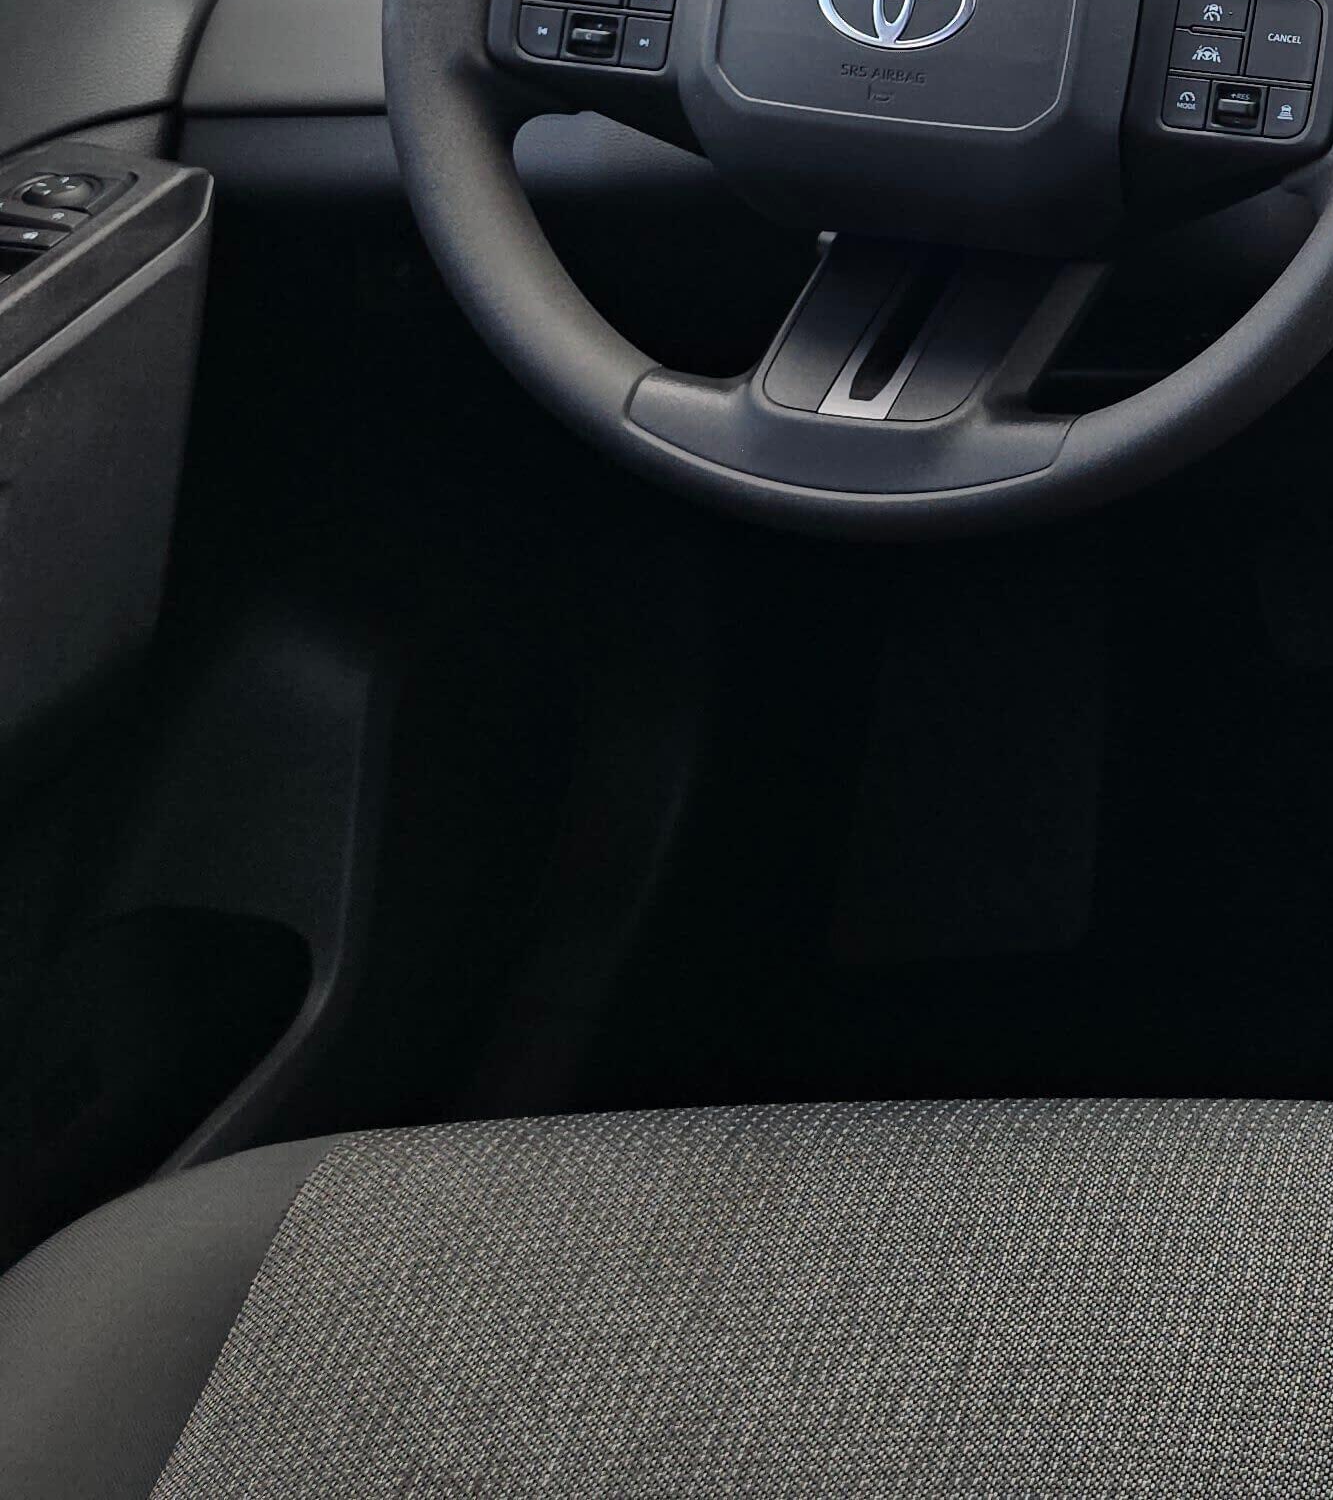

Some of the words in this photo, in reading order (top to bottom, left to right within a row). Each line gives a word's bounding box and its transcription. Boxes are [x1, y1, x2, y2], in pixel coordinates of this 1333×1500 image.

[1267, 32, 1302, 45] CANCEL
[840, 63, 867, 78] SRS
[871, 67, 928, 84] AIRBAG
[1176, 102, 1197, 111] MODE
